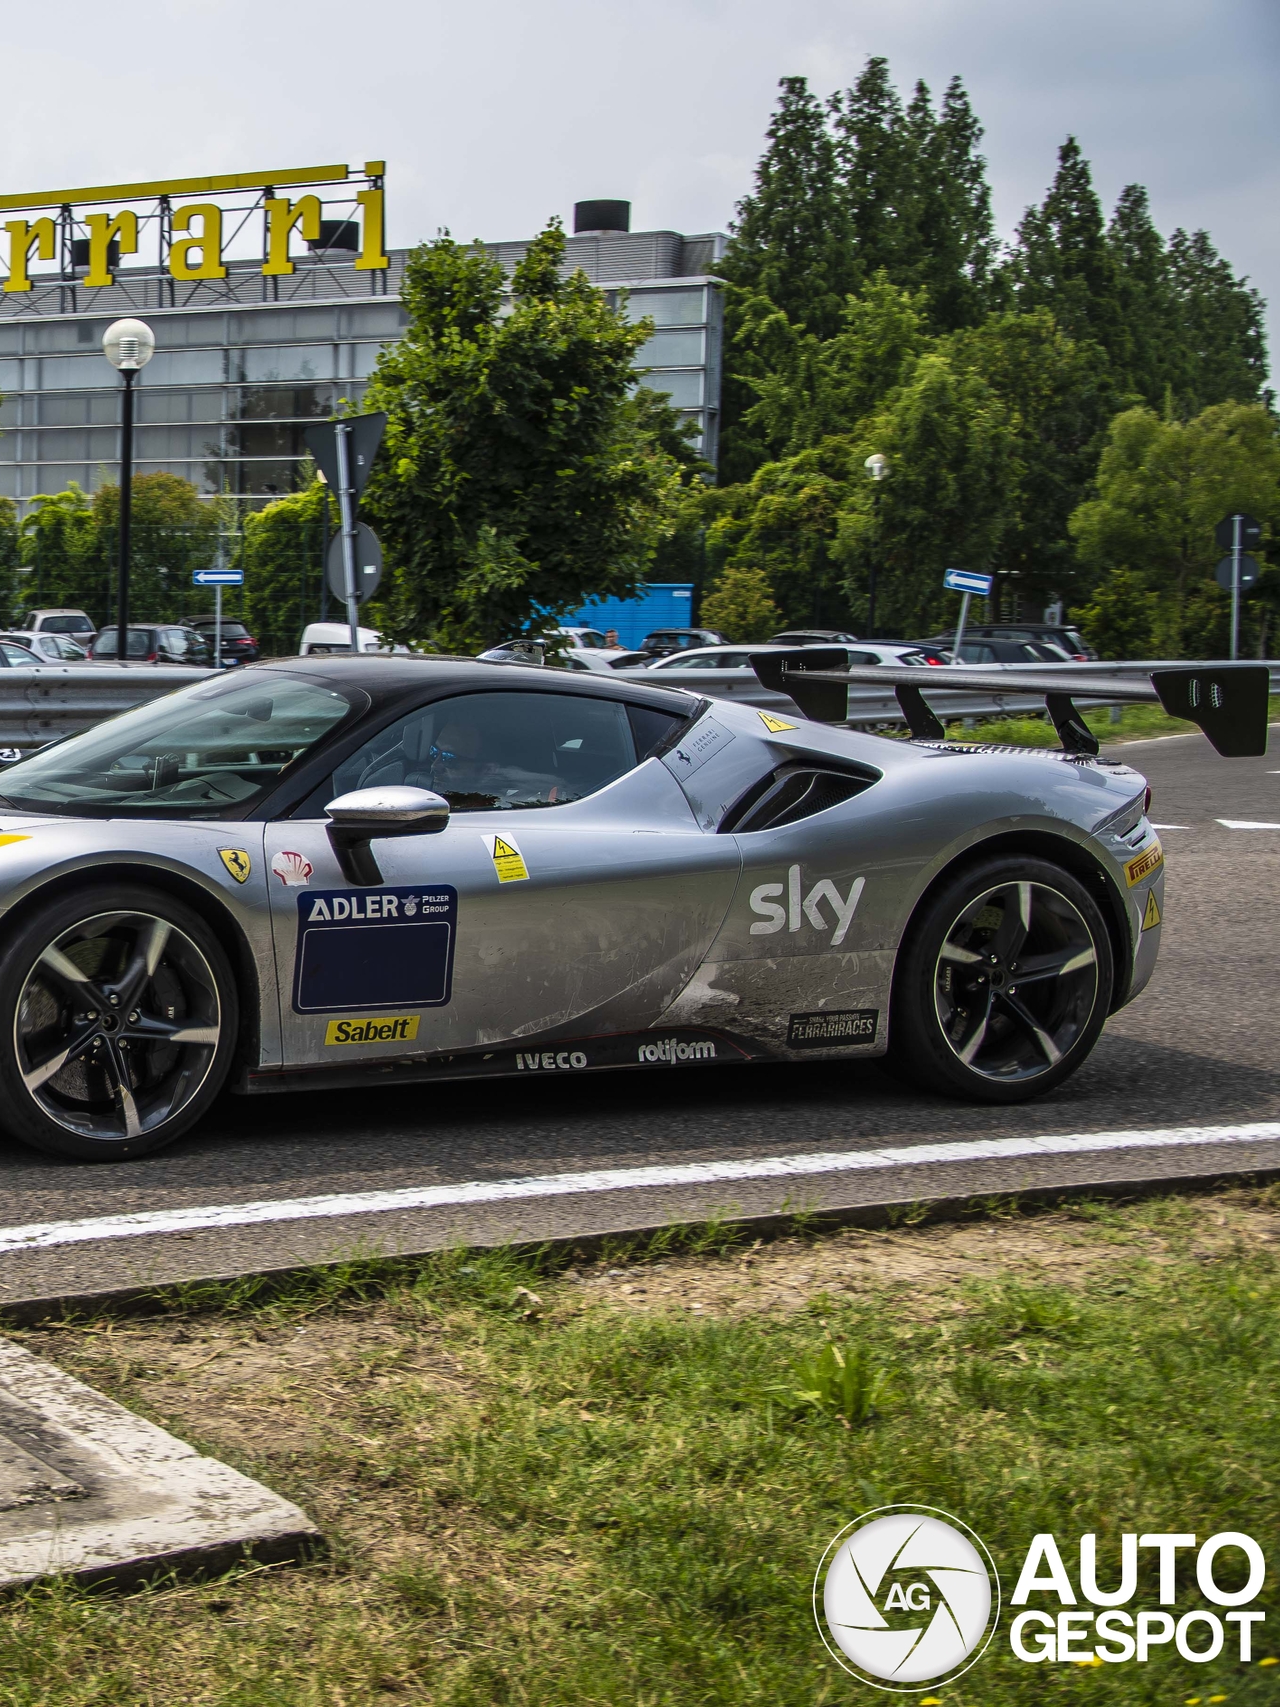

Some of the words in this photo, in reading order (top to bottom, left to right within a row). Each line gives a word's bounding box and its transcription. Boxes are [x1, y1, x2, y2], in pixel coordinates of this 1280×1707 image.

[692, 728, 716, 748] FERRARI
[697, 732, 721, 753] GENUINE
[1128, 846, 1161, 881] PIRELLI
[307, 894, 399, 922] ADLER
[422, 895, 450, 904] PELZER
[422, 905, 450, 914] GROUP
[749, 864, 866, 945] sky
[334, 1018, 411, 1043] Sabelt
[516, 1051, 588, 1070] IVECO
[638, 1038, 716, 1065] rotiform
